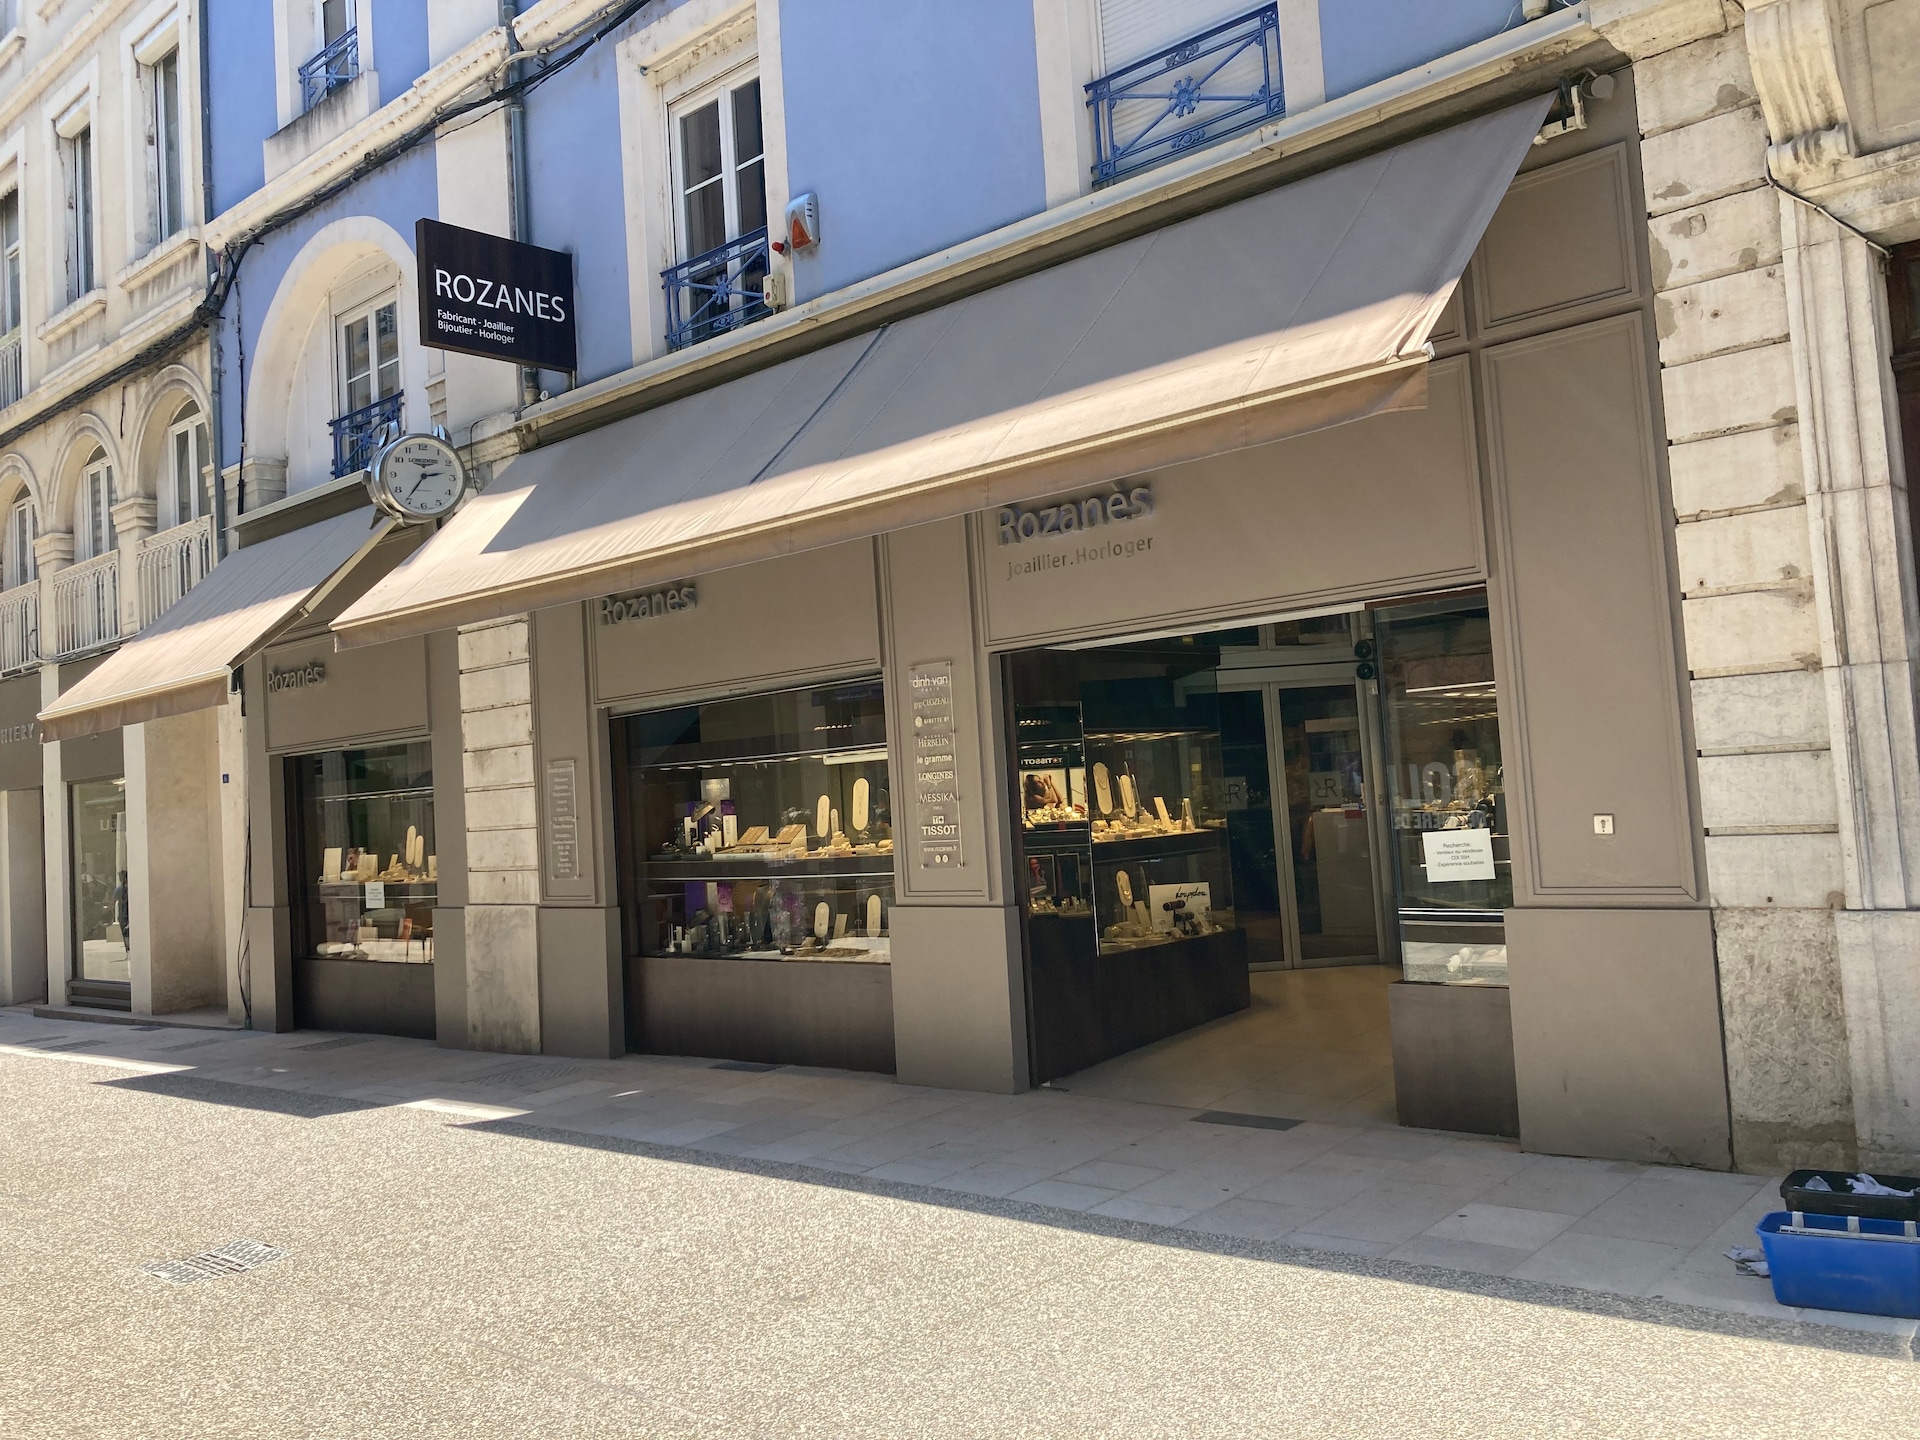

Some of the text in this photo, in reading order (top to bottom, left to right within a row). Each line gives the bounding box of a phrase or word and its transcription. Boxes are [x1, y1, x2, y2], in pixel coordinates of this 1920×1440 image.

[435, 268, 566, 323] ROZANES
[437, 309, 477, 326] Fabricant
[483, 319, 515, 333] Joaillier
[438, 321, 473, 336] Bijoutier
[479, 330, 515, 345] Horloger
[997, 483, 1154, 547] Rozanès
[267, 662, 325, 693] Rozanès
[912, 674, 948, 688] dinh van
[916, 754, 953, 766] le gramme
[918, 770, 953, 781] LONGINES
[919, 792, 955, 804] MESSIKA
[921, 825, 957, 836] TISSOT
